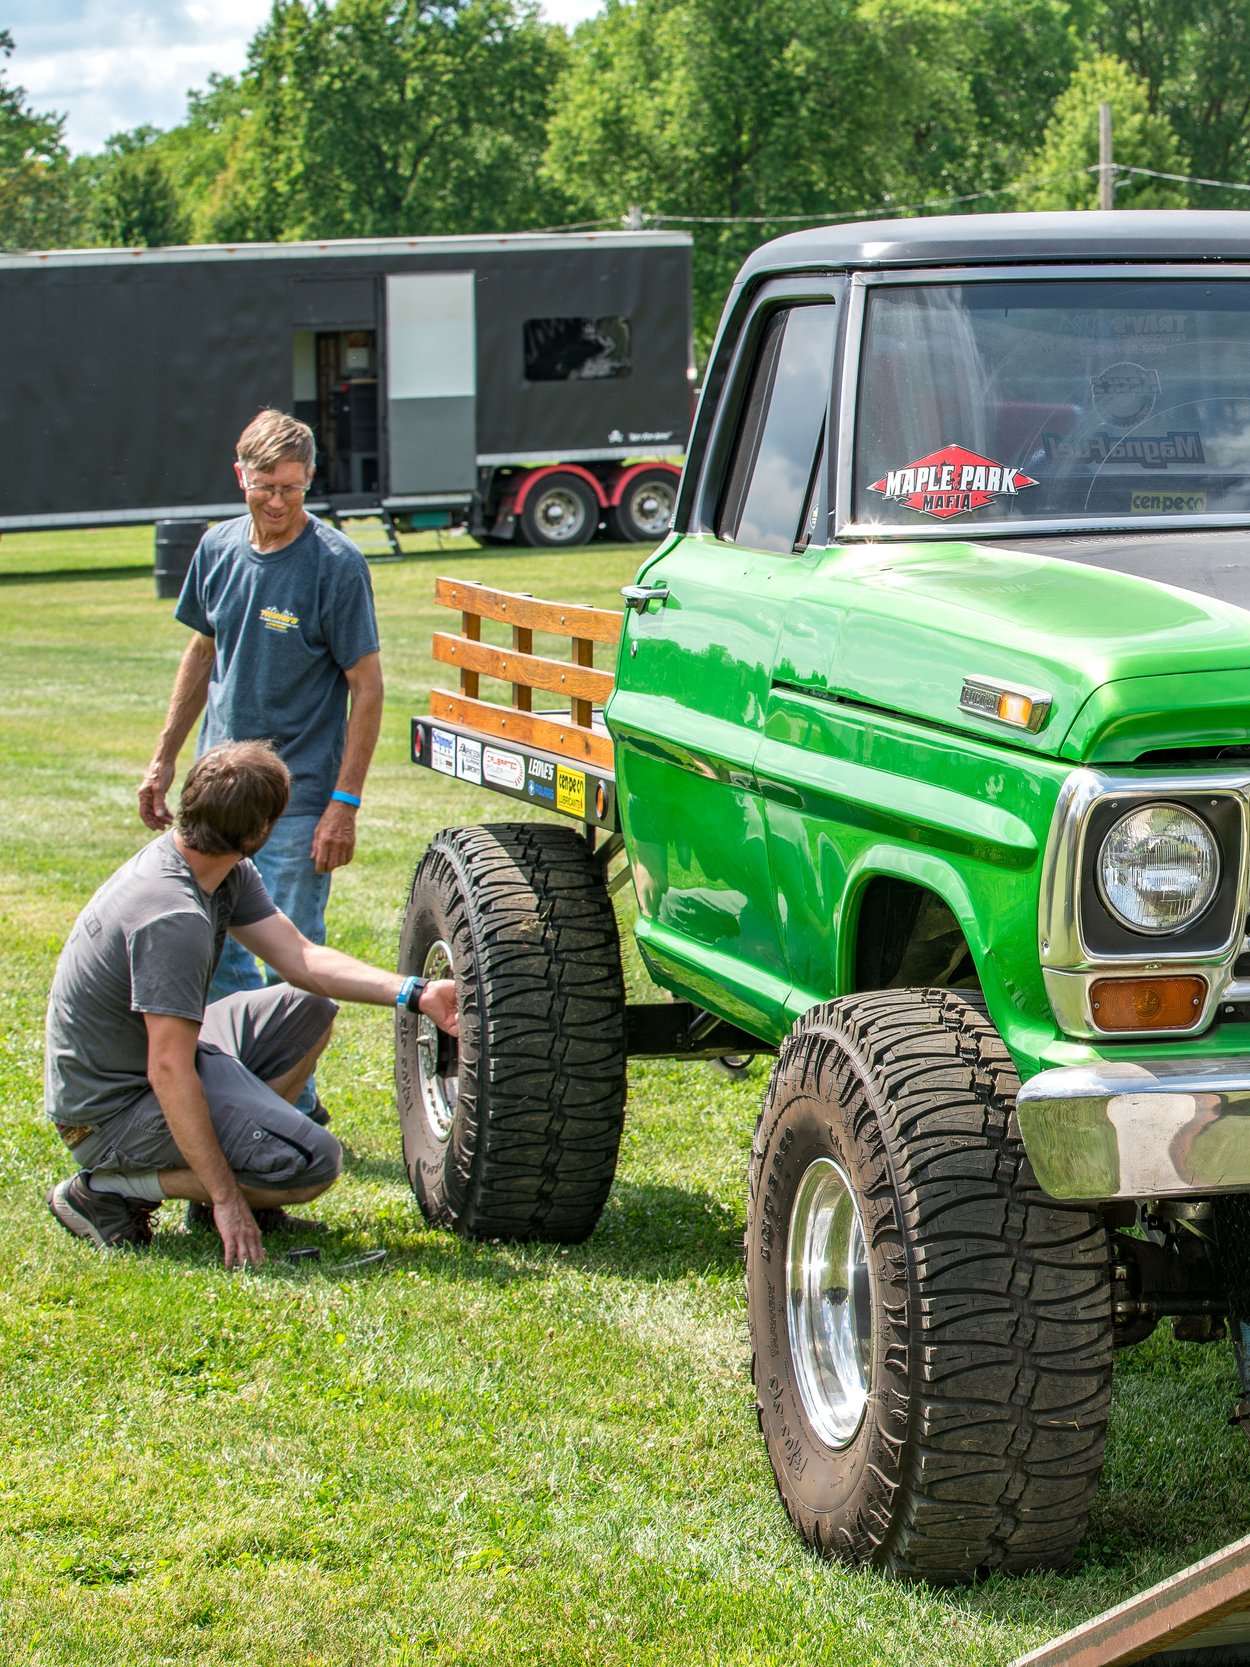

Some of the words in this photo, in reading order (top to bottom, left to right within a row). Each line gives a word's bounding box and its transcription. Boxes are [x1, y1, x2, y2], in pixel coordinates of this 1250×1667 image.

[886, 466, 955, 497] MAPLE
[960, 465, 1020, 493] PARK
[923, 493, 972, 510] MAFIA
